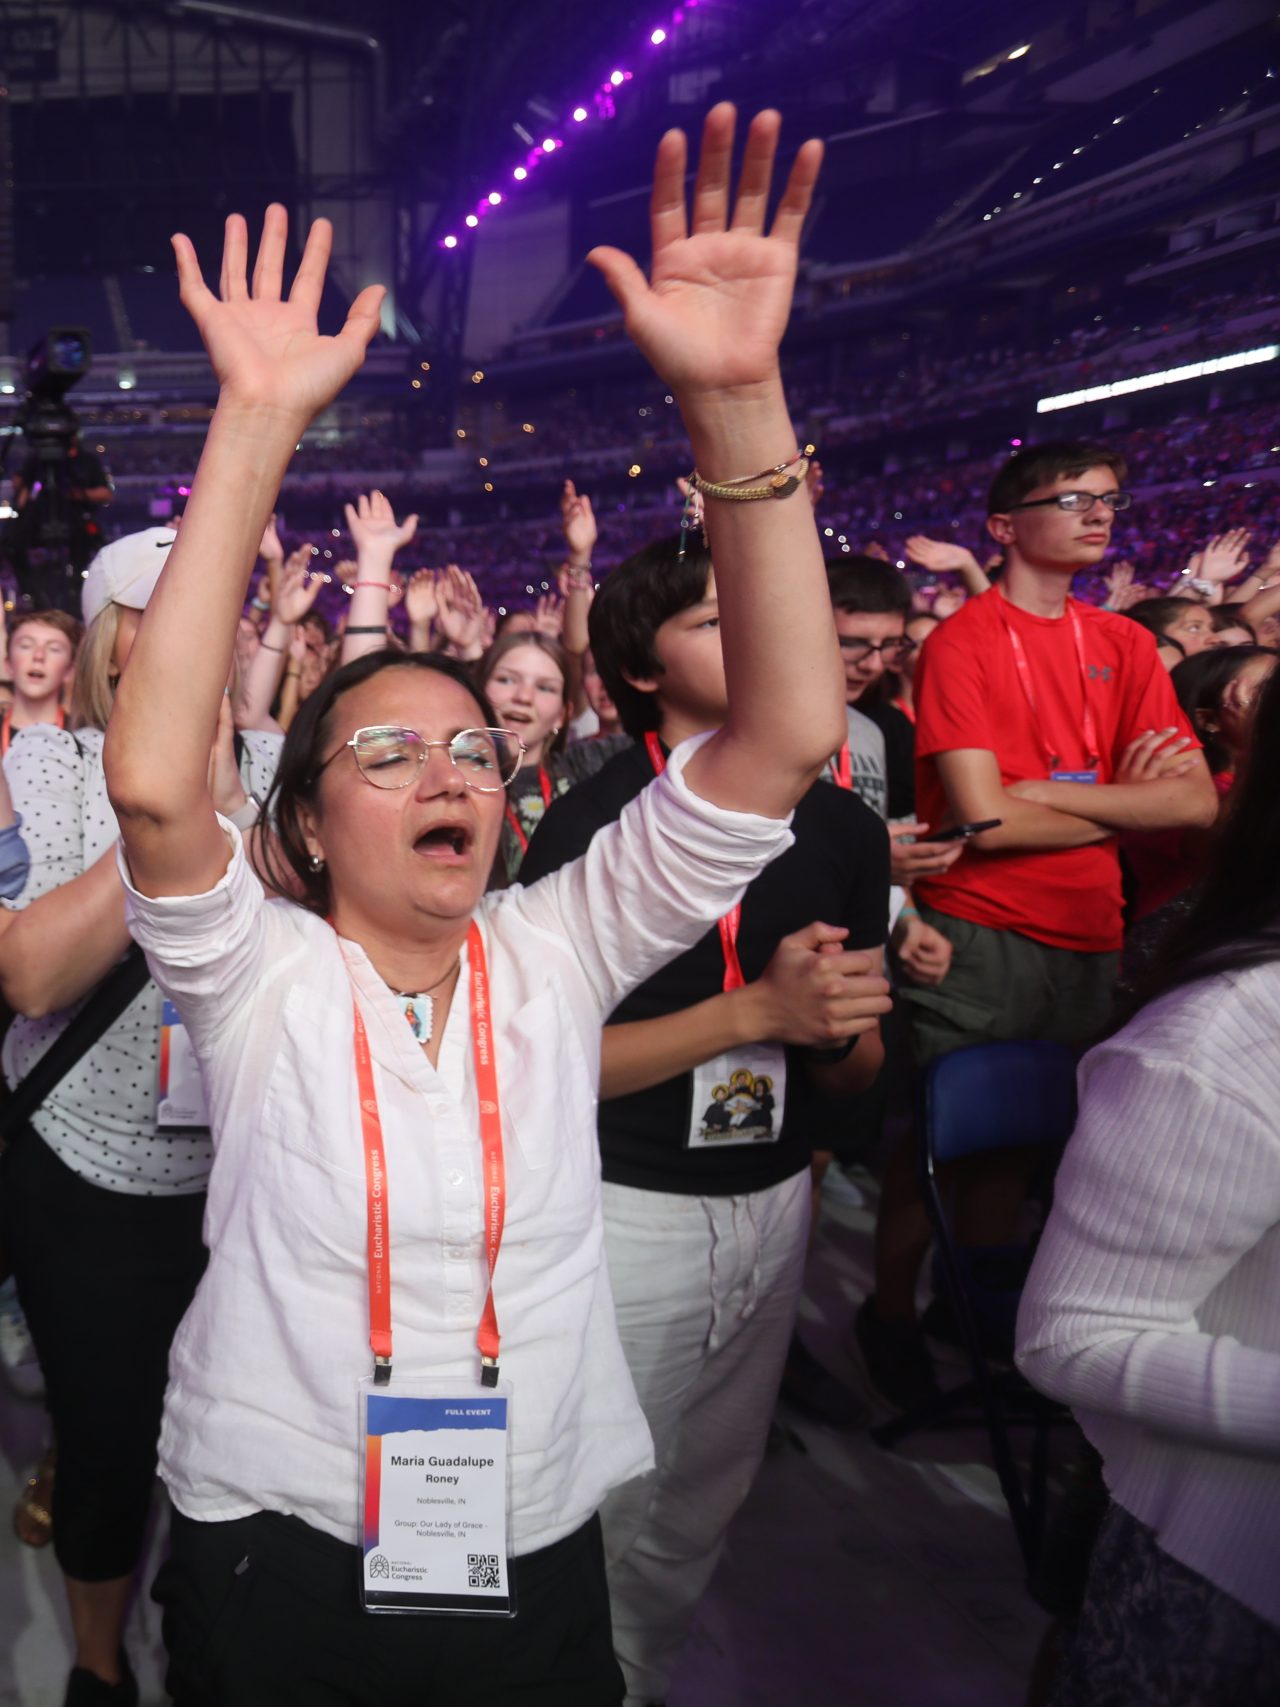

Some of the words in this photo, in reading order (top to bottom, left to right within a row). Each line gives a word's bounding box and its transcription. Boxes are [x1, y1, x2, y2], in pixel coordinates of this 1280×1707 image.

[371, 1149, 383, 1198] Congress
[490, 1186, 501, 1245] Eucharistic
[372, 1201, 384, 1259] Eucharistic
[391, 1456, 425, 1466] Maria
[428, 1456, 495, 1469] Guadalupe
[425, 1474, 460, 1485] Roney
[416, 1497, 456, 1505] Noblesville,
[394, 1520, 418, 1529] Group:
[419, 1520, 433, 1528] Our
[434, 1521, 452, 1529] Lady
[462, 1521, 483, 1529] Grace
[416, 1530, 456, 1538] Noblesville,
[391, 1573, 423, 1581] Congress
